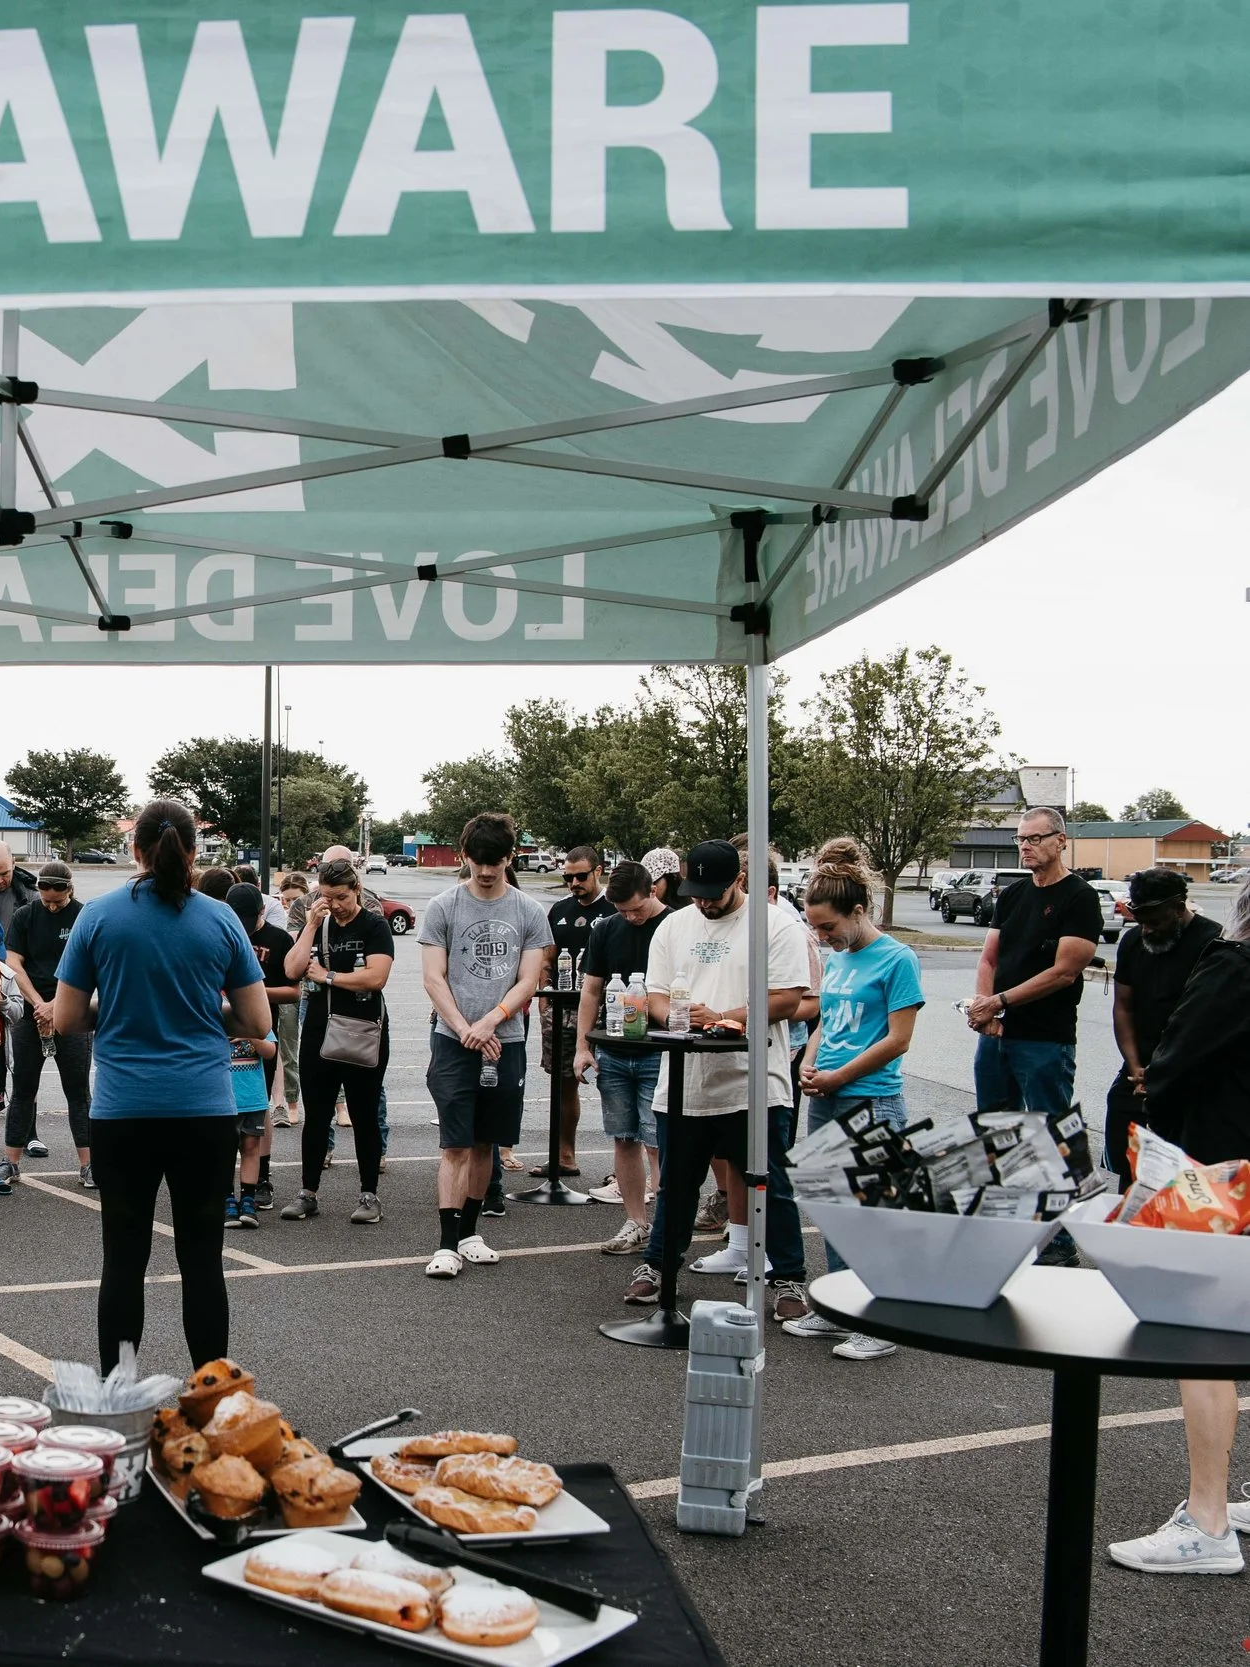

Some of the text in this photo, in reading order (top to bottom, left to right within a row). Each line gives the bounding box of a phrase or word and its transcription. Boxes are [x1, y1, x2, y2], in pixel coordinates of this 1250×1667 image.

[468, 923, 510, 941] CLASS OF
[475, 942, 505, 957] 2019
[470, 962, 510, 978] SENIOR
